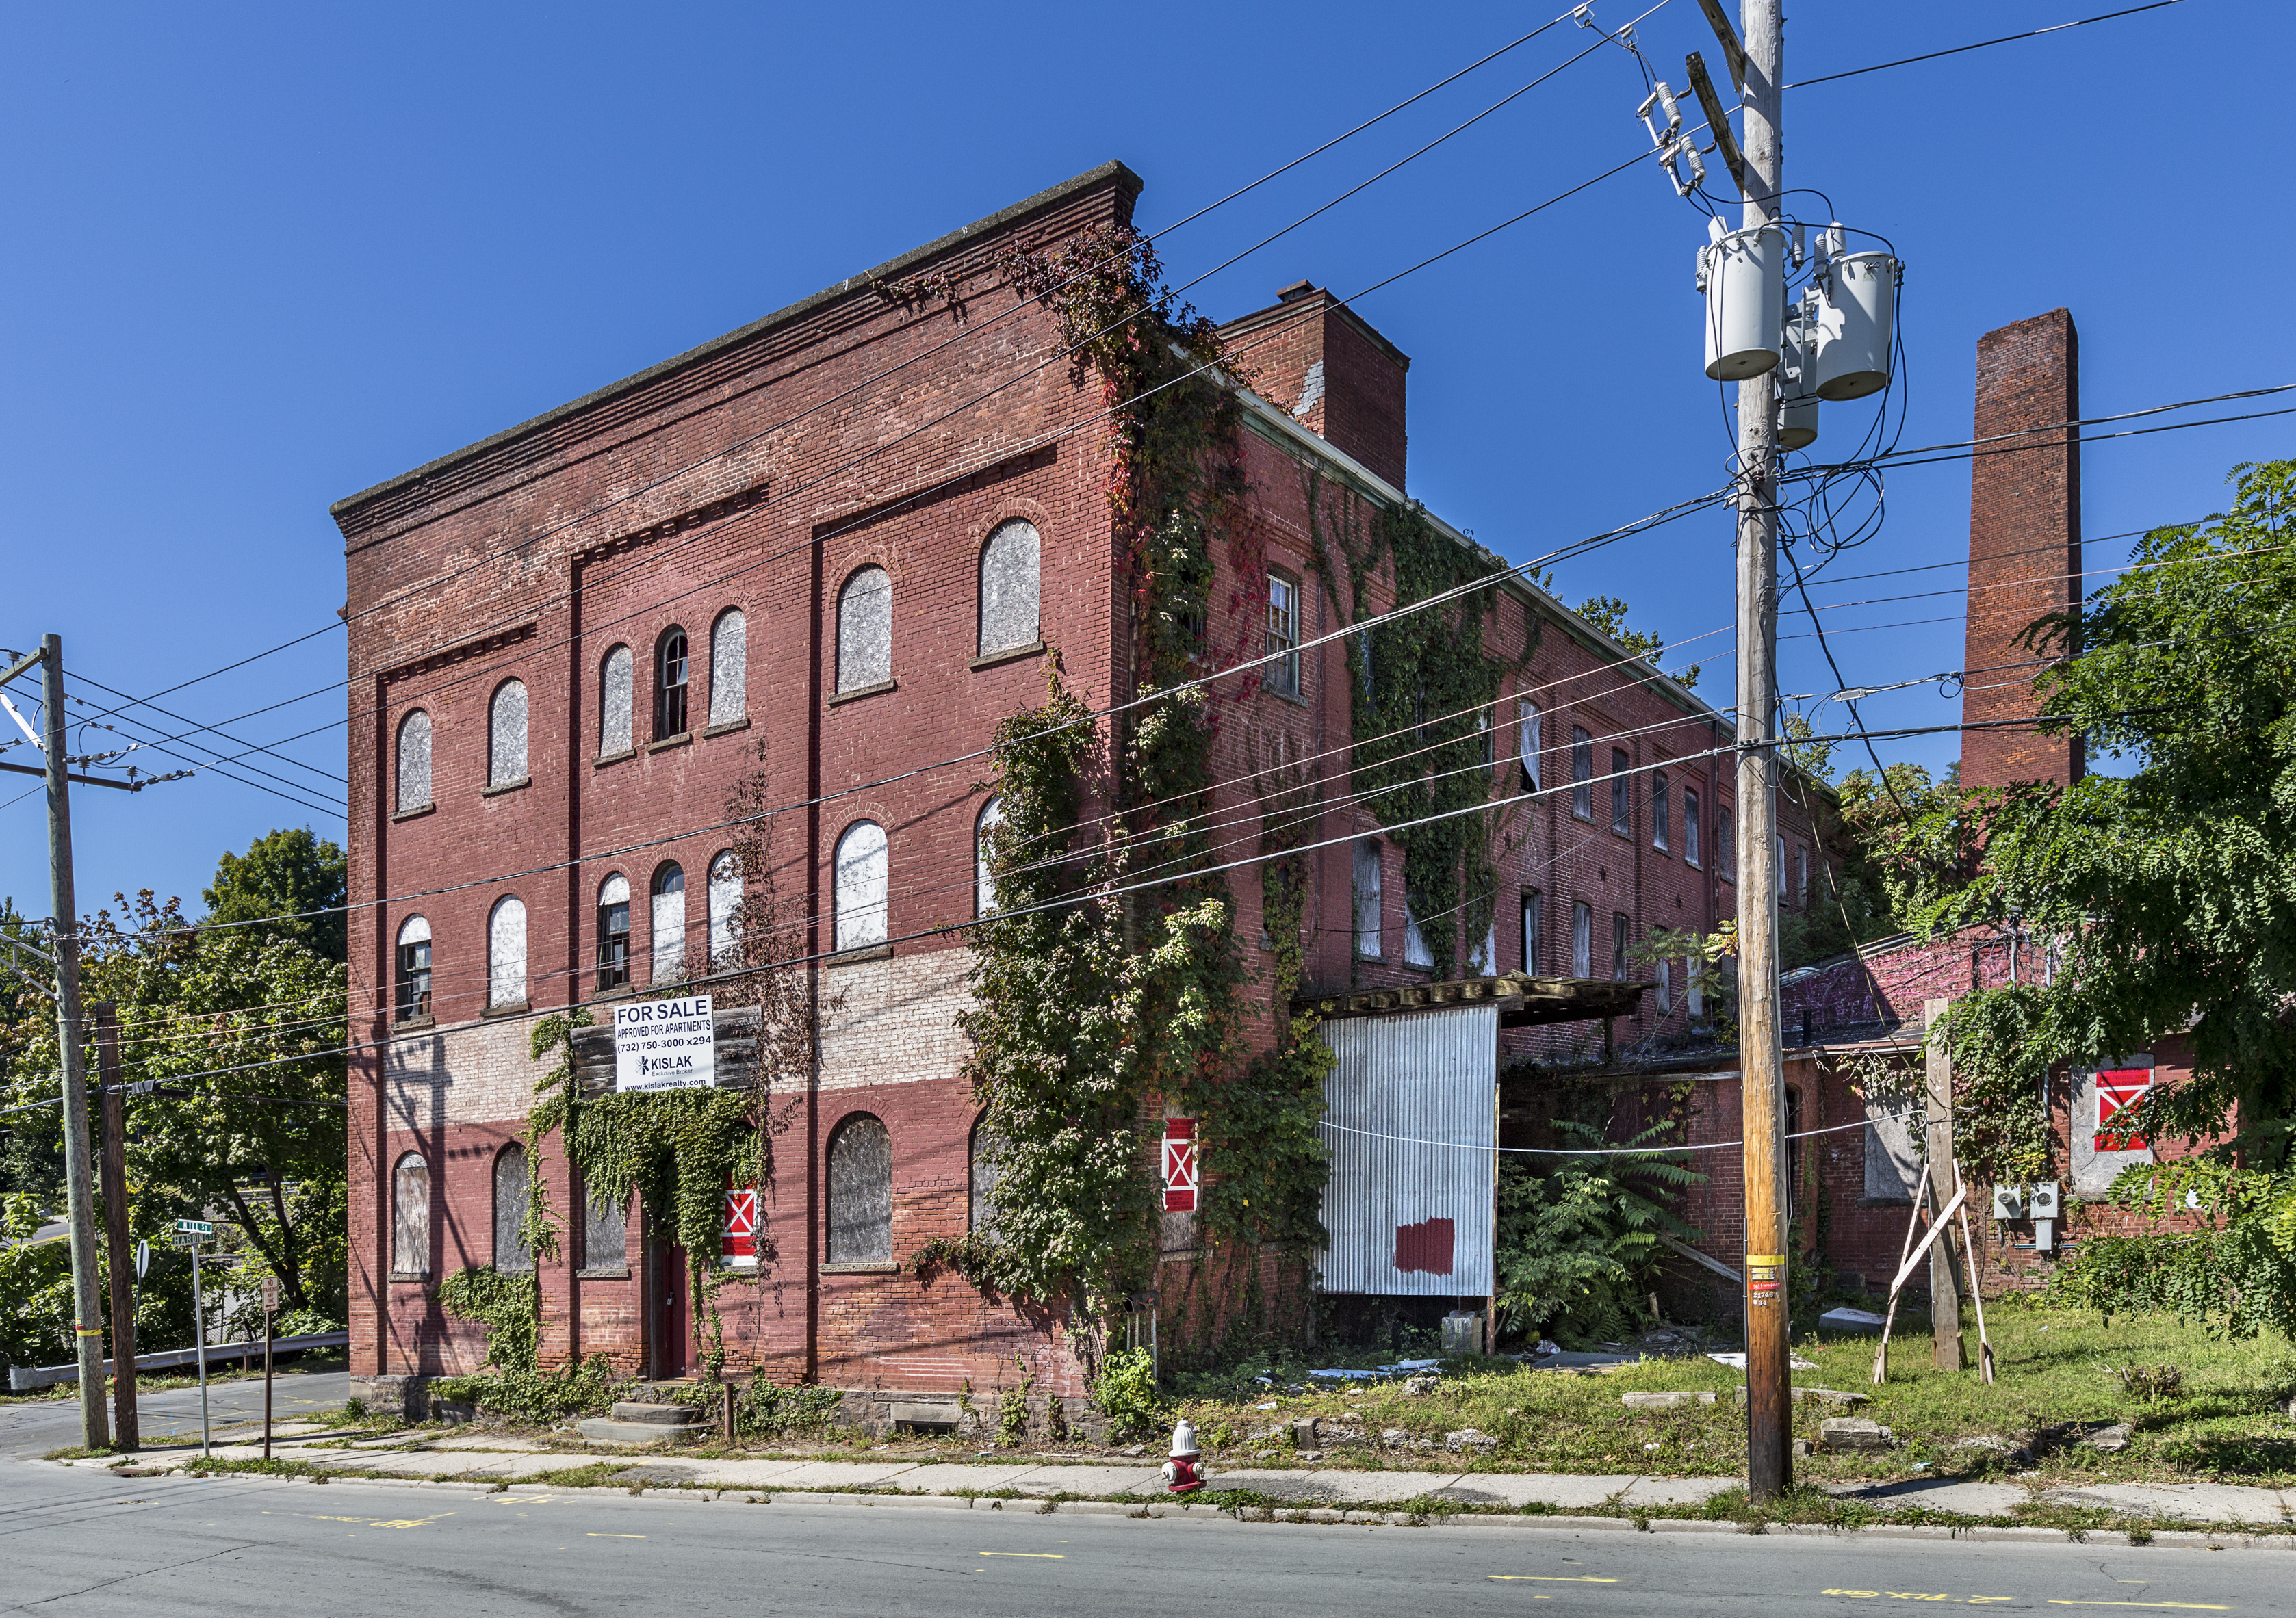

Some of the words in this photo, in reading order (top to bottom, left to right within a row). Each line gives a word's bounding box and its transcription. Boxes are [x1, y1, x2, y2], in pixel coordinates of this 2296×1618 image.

[618, 1006, 653, 1024] FOR
[657, 1000, 708, 1019] SALE
[617, 1026, 649, 1039] APPROVED
[651, 1024, 664, 1036] FOR
[665, 1019, 711, 1034] APARTMENTS
[617, 1042, 639, 1054] (732)
[641, 1038, 684, 1050] 750-3000
[686, 1036, 712, 1046] x294
[651, 1055, 693, 1070] KISLAK
[624, 1079, 706, 1091] www.kislakrealty.com
[183, 1221, 198, 1231] MILL
[174, 1234, 208, 1244] HARDING
